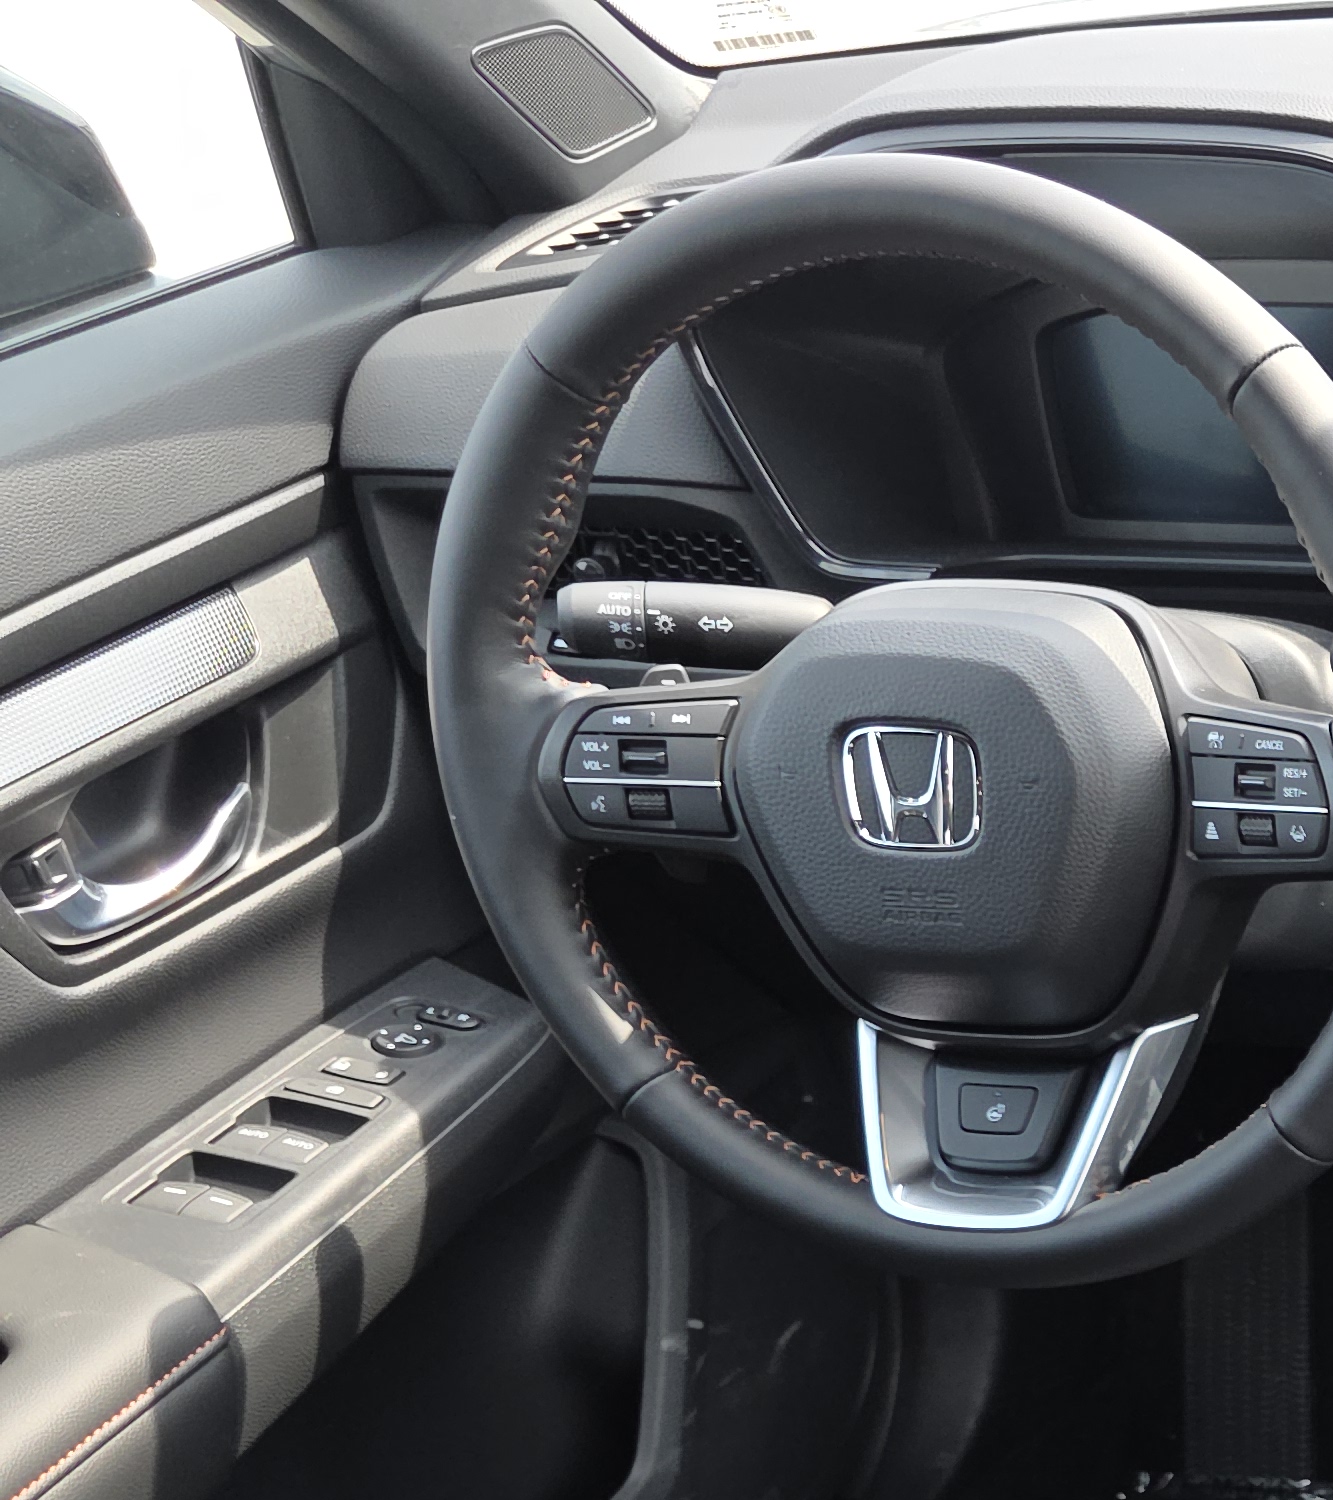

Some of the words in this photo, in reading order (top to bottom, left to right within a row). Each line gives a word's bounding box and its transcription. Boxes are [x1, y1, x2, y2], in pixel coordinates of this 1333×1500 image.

[597, 604, 631, 616] AUTO
[581, 741, 610, 752] VOL+
[1255, 739, 1284, 751] CANCEL
[881, 887, 959, 908] SRS
[238, 1128, 269, 1138] AUTO
[282, 1137, 314, 1150] AUTO
